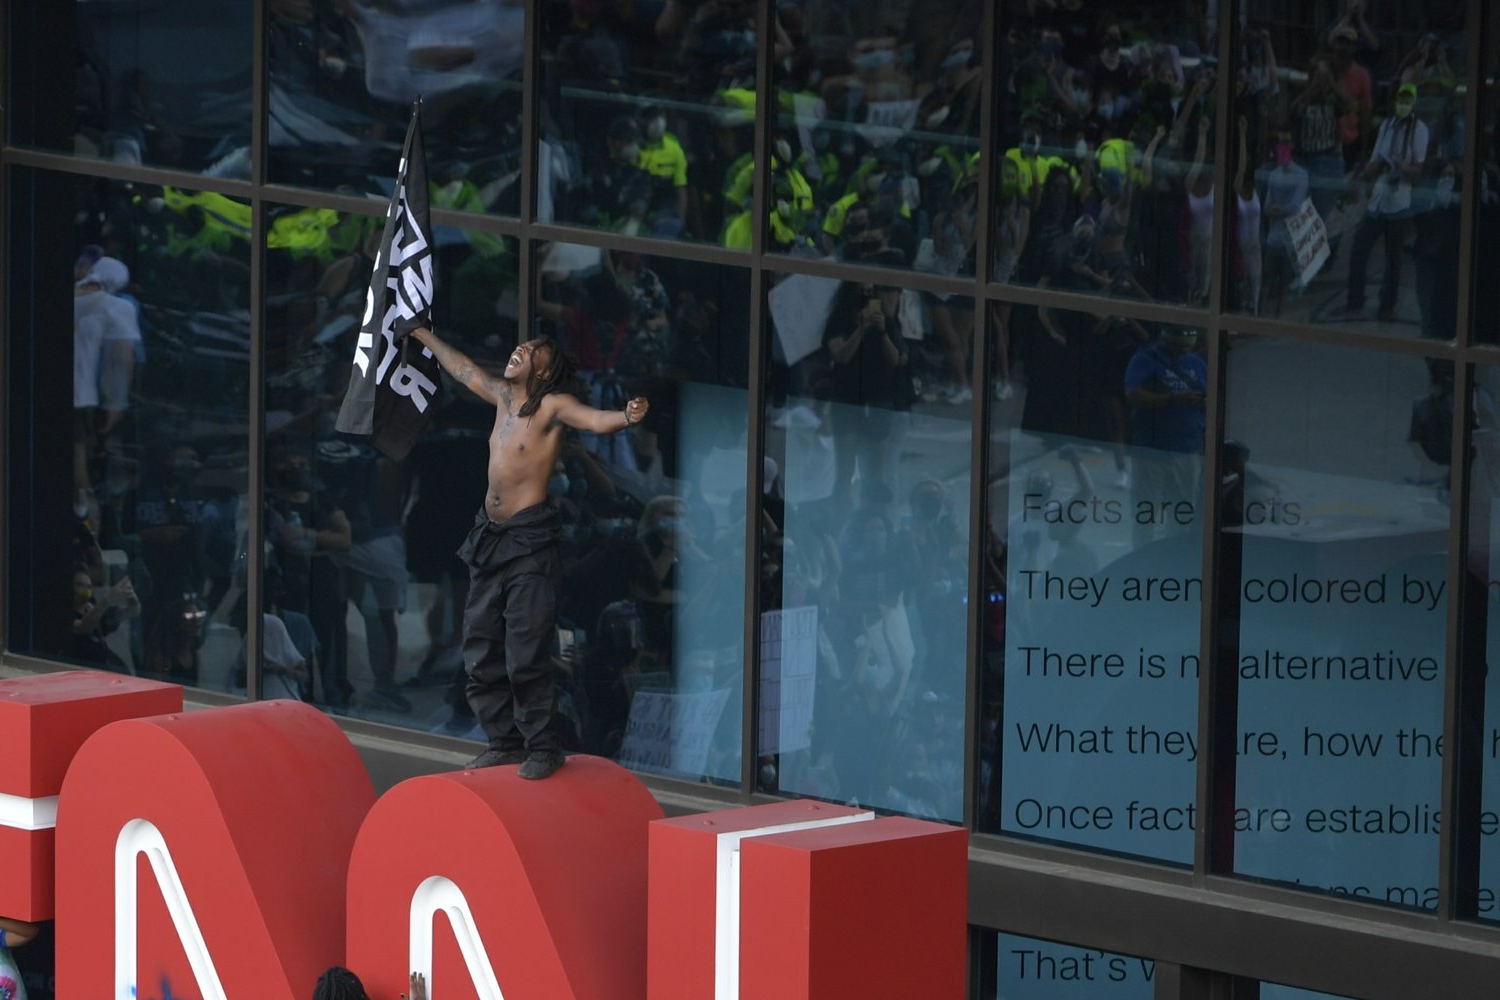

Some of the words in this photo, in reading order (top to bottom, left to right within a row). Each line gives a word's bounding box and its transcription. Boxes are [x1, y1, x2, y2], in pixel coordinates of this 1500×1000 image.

[1022, 492, 1122, 524] Facts
[1135, 500, 1195, 525] are
[1246, 498, 1311, 526] cts.
[1019, 570, 1110, 608] They
[1122, 576, 1203, 602] aren
[1243, 573, 1387, 604] colored
[1402, 574, 1446, 612] by
[1017, 647, 1125, 678] There
[1139, 647, 1166, 678] is
[1180, 654, 1201, 679] n
[1240, 650, 1439, 681] alternative
[1016, 723, 1114, 754] What
[1126, 725, 1199, 762] they
[1237, 731, 1288, 760] re,
[1303, 726, 1383, 757] how
[1396, 728, 1444, 758] the
[1015, 798, 1114, 830] Once
[1126, 801, 1197, 831] fact
[1234, 807, 1291, 833] are
